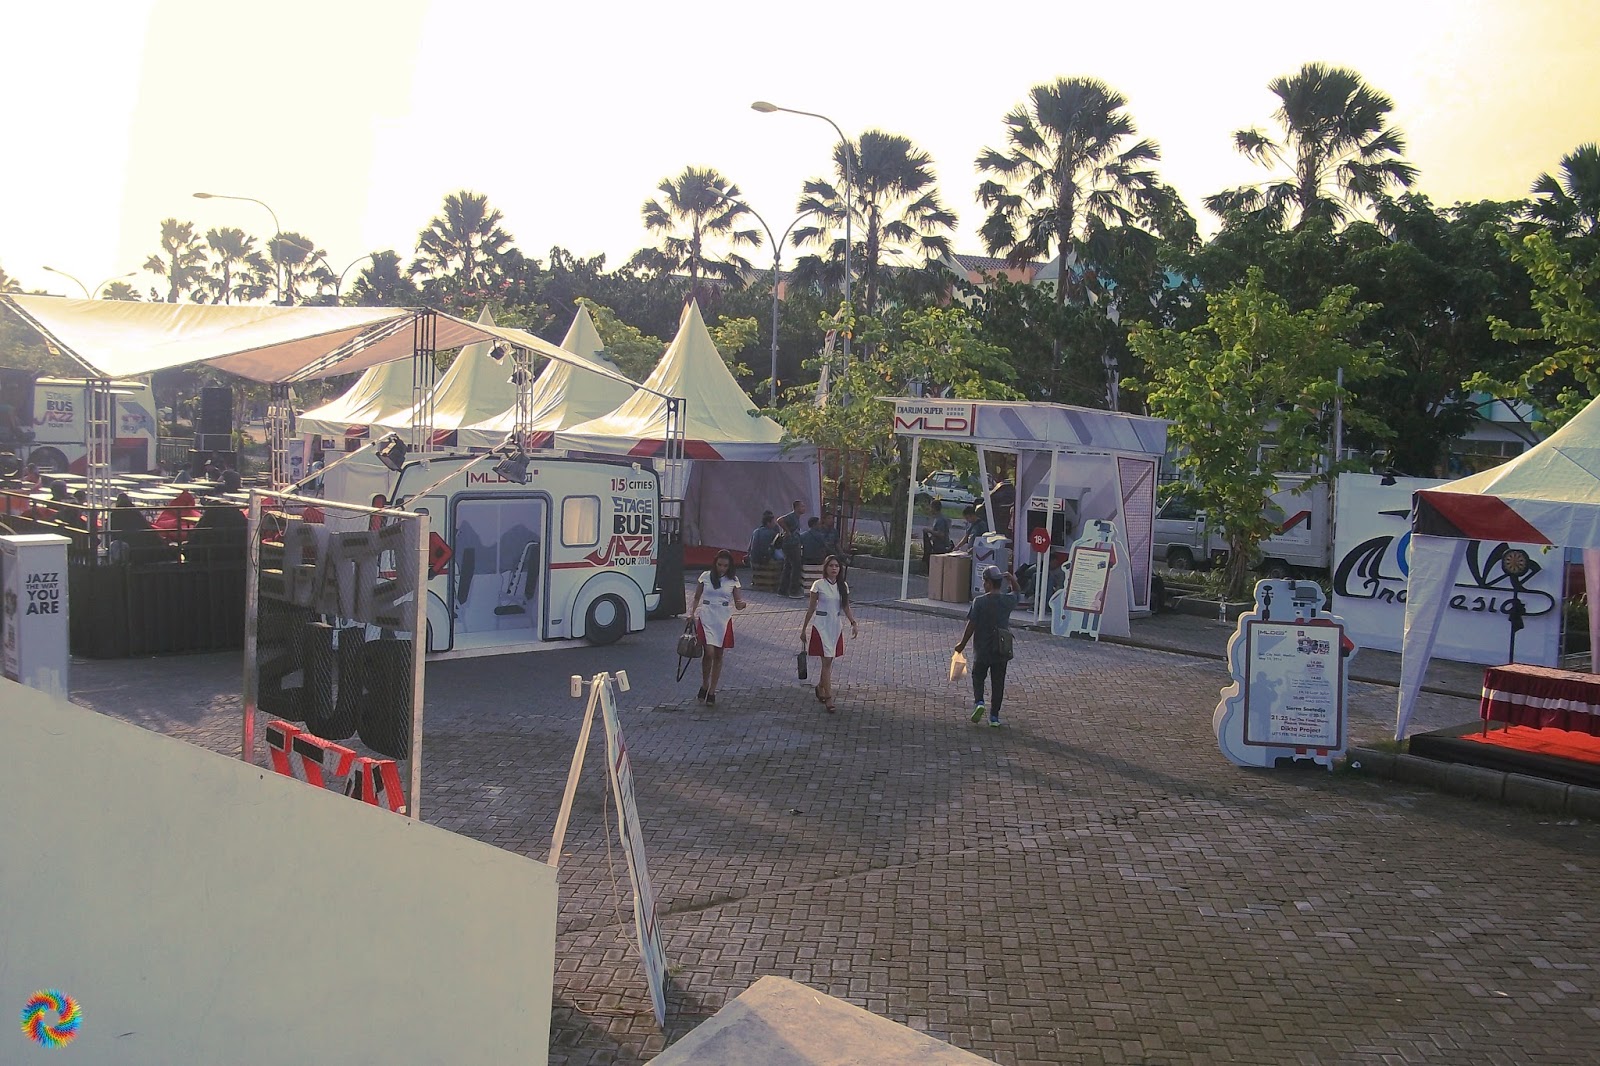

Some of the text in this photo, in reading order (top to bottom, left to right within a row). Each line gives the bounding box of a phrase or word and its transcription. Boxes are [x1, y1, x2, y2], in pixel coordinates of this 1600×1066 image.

[46, 400, 73, 411] BUS
[897, 406, 944, 415] DJARUM SUPER
[33, 411, 74, 426] JAZZ
[895, 416, 968, 430] MLD
[611, 478, 655, 491] 15 CITIES
[611, 496, 653, 514] STAGE
[613, 515, 653, 535] BUS
[1033, 534, 1047, 545] 18+
[584, 536, 653, 566] JAZZ
[614, 557, 636, 566] TOUR
[26, 572, 59, 584] JAZZ
[27, 589, 59, 601] YOU
[26, 601, 59, 615] ARE
